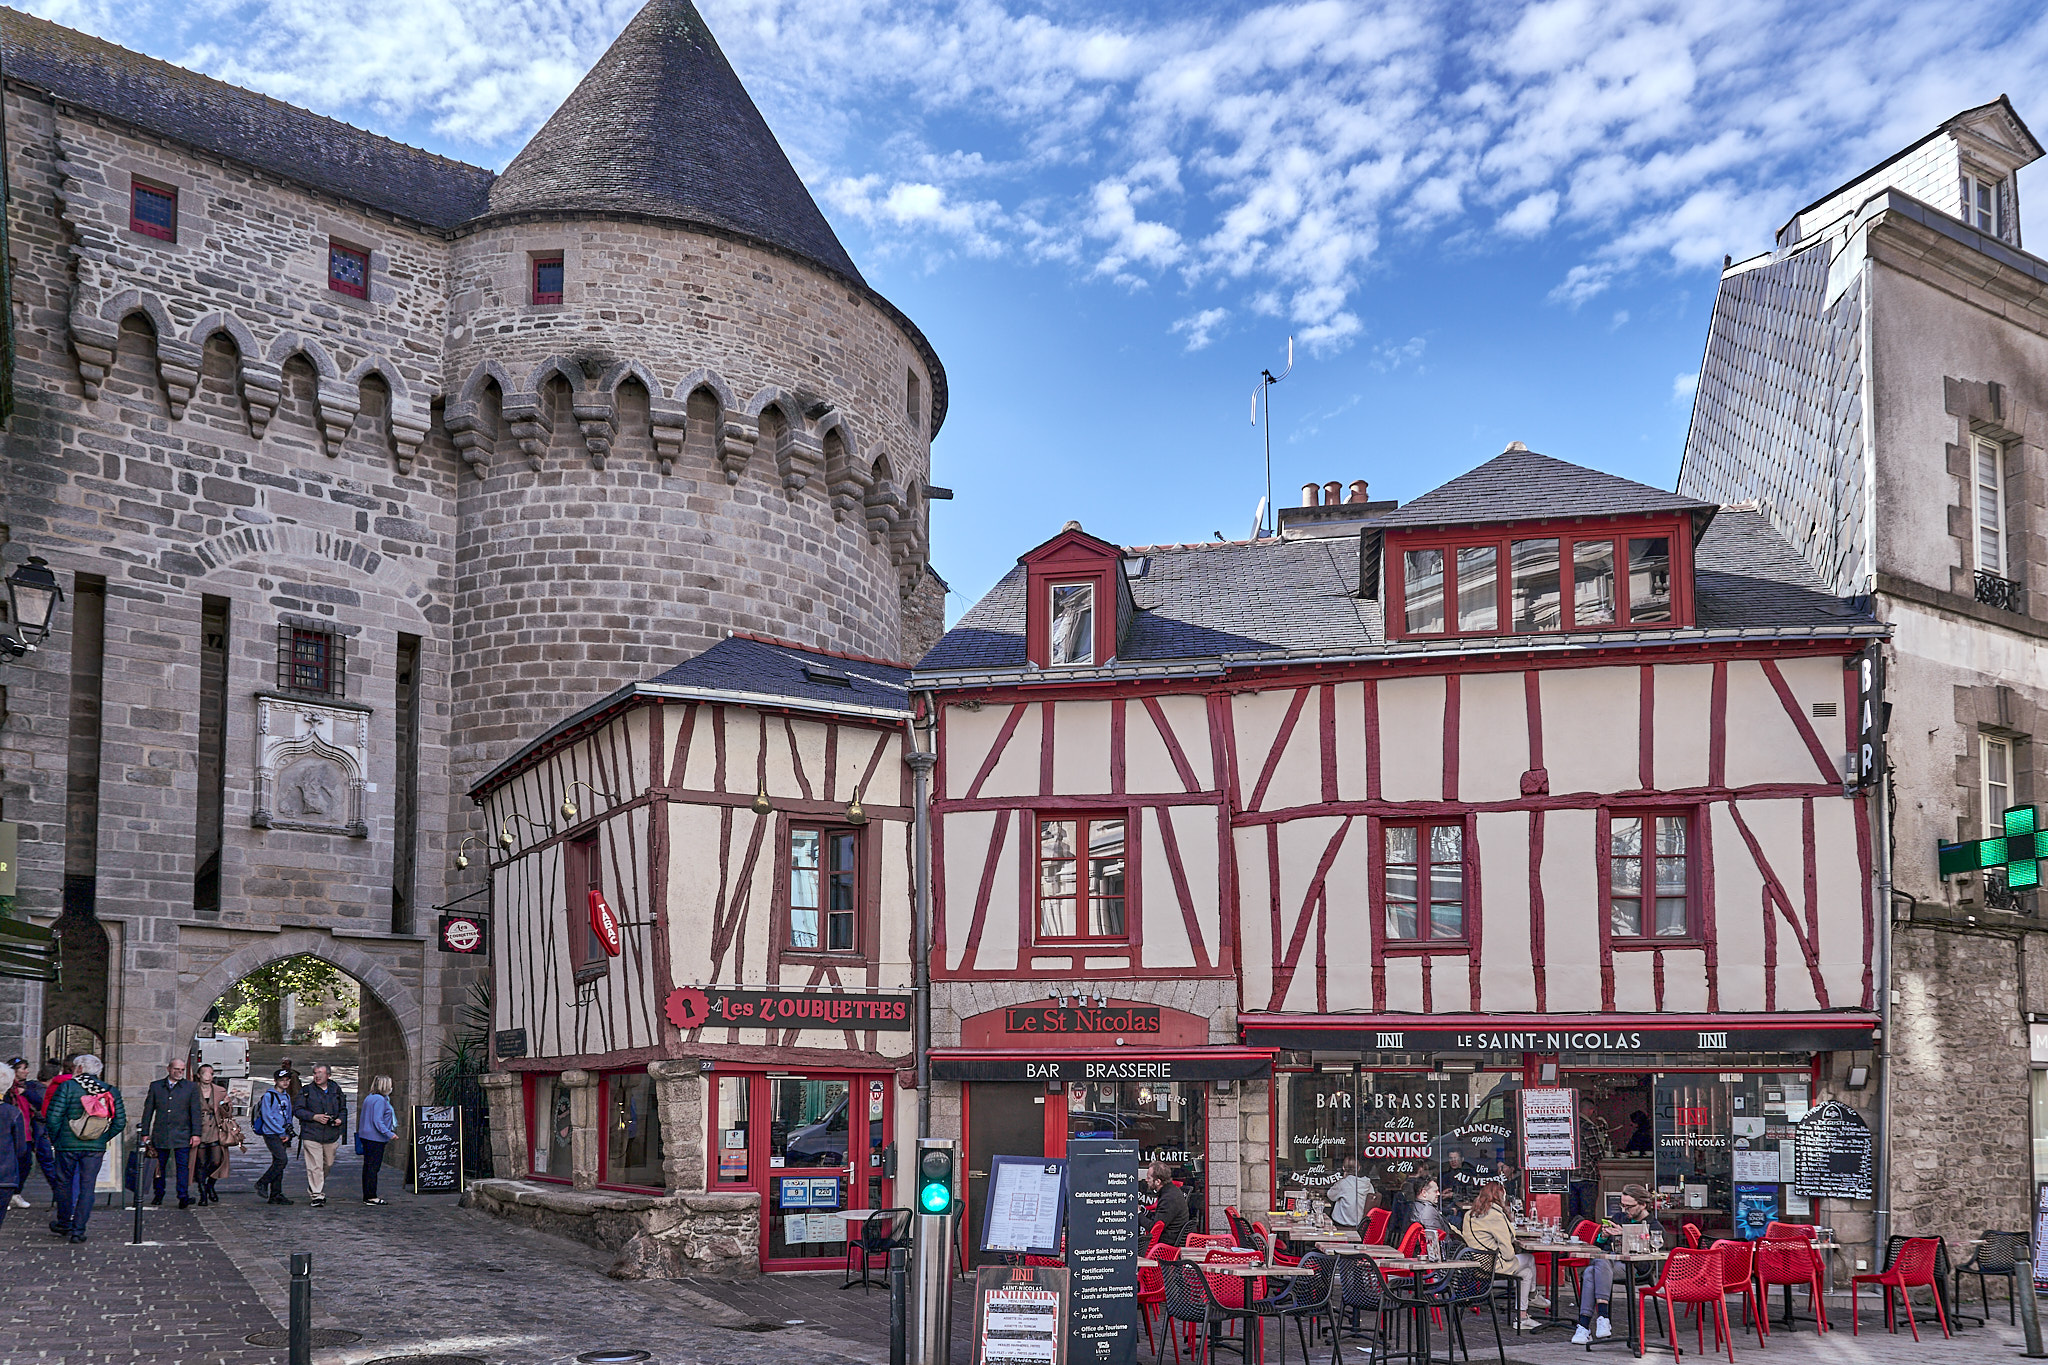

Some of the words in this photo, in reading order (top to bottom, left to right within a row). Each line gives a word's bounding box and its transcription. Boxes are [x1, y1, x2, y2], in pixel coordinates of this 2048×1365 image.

[1862, 658, 1872, 777] BAR
[598, 904, 618, 945] TABAC
[722, 997, 754, 1020] Les
[1007, 1010, 1037, 1031] Le
[1043, 1009, 1067, 1032] St
[1074, 1009, 1160, 1032] Nicolas
[1457, 1035, 1472, 1047] LE
[1478, 1032, 1641, 1049] SAINT-NICOLAS
[1026, 1063, 1060, 1078] BAR
[1086, 1062, 1171, 1078] BRASSERIE
[1316, 1093, 1352, 1108] BAR
[1375, 1092, 1482, 1108] BRASSERIE
[1384, 1116, 1396, 1128] de
[1397, 1116, 1414, 1128] 12h
[1454, 1124, 1512, 1138] PLANCHES
[1294, 1134, 1310, 1144] toute
[1312, 1134, 1319, 1144] la
[1368, 1132, 1428, 1144] SERVICE
[1472, 1135, 1492, 1146] apéro
[1660, 1138, 1726, 1147] SAINT-NICOLAS
[1145, 1151, 1156, 1161] LA
[1160, 1151, 1190, 1161] CARTE
[1364, 1146, 1432, 1158] CONTINU
[1307, 1164, 1326, 1175] petit
[1387, 1162, 1395, 1172] à
[1396, 1160, 1414, 1172] 18h
[1476, 1164, 1489, 1174] Vin
[1291, 1172, 1344, 1186] DÉJEUNER
[1454, 1172, 1470, 1184] AU
